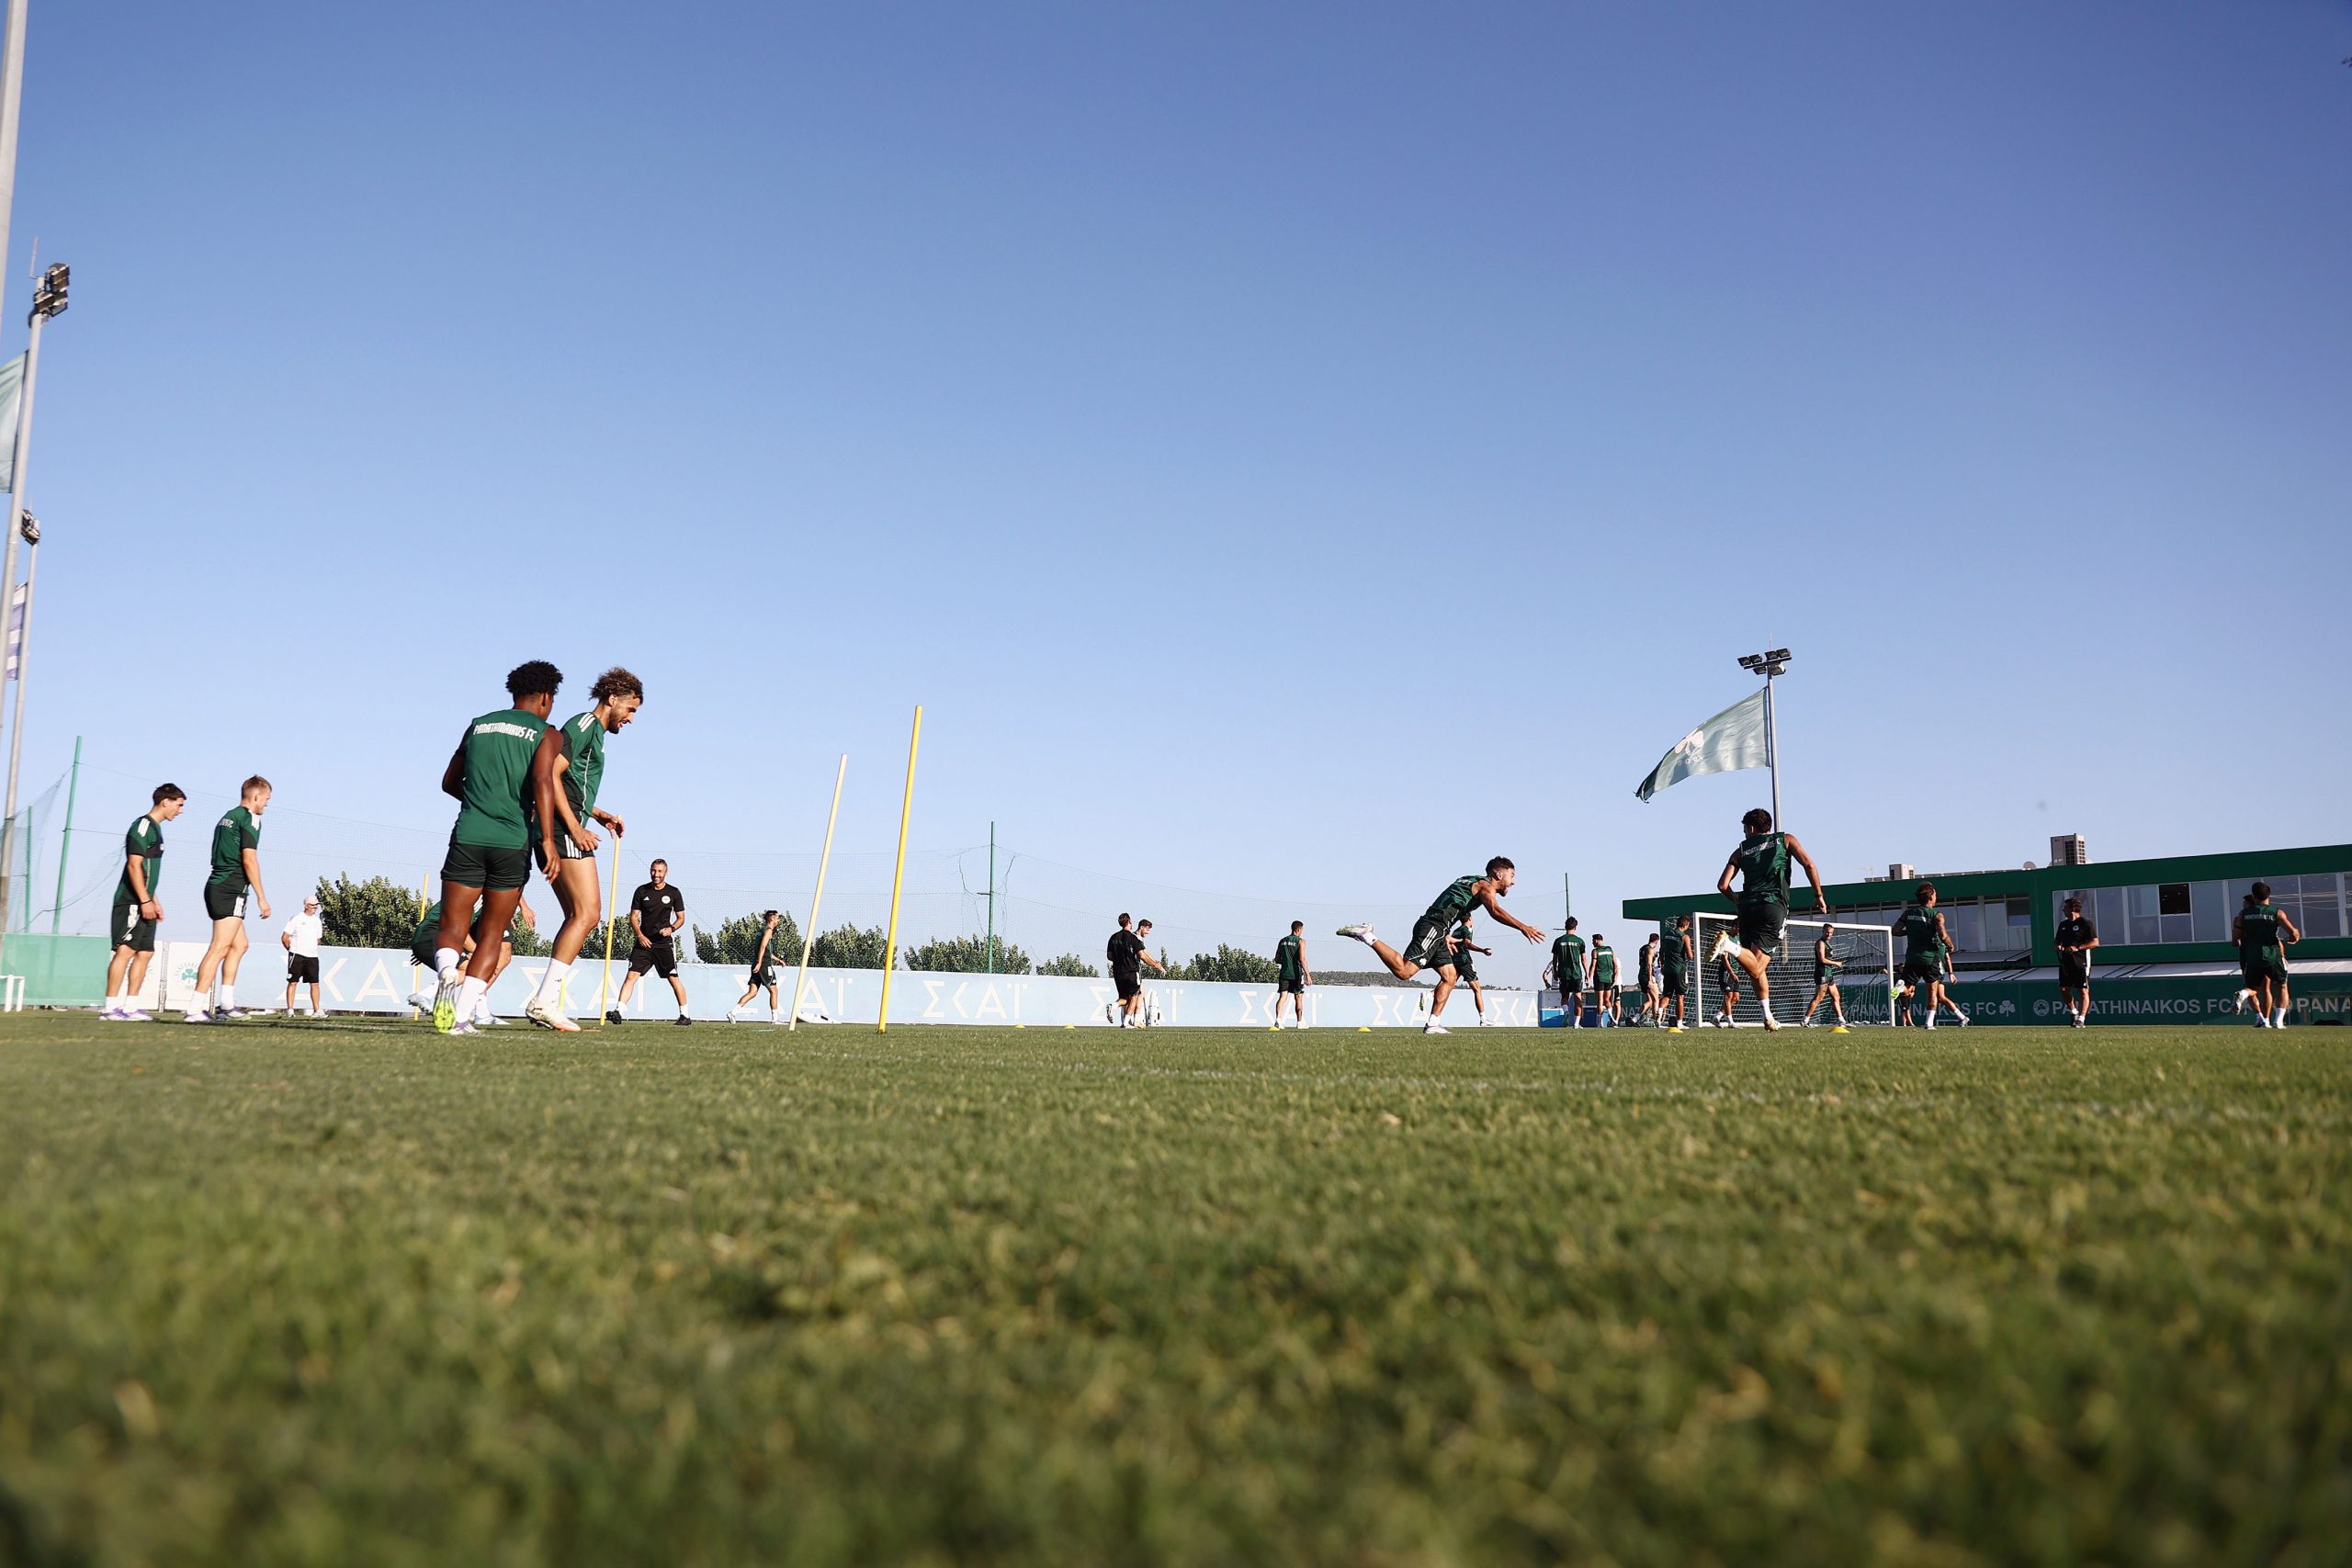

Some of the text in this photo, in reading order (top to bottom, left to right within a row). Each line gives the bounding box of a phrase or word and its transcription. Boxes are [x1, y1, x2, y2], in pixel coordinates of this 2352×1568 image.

[525, 728, 537, 741] FC
[1976, 1001, 1996, 1016] FC
[2207, 998, 2232, 1013] FC
